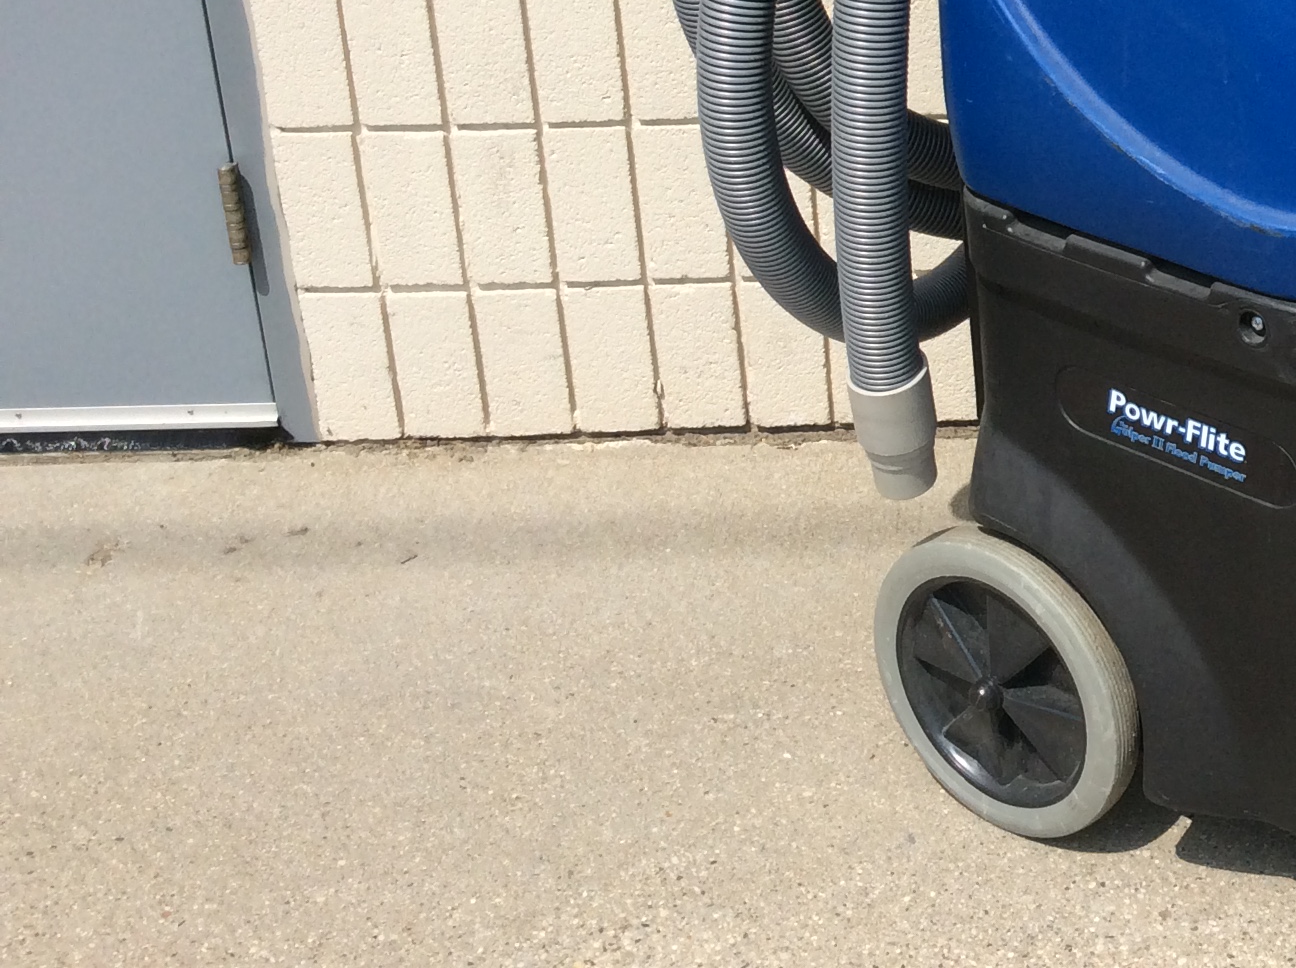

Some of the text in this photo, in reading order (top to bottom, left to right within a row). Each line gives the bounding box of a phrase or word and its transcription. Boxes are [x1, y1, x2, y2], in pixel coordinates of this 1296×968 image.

[1107, 388, 1246, 464] Powr-Flite
[1151, 435, 1165, 451] II
[1165, 442, 1198, 464] Flood
[1199, 455, 1247, 482] Pumper
